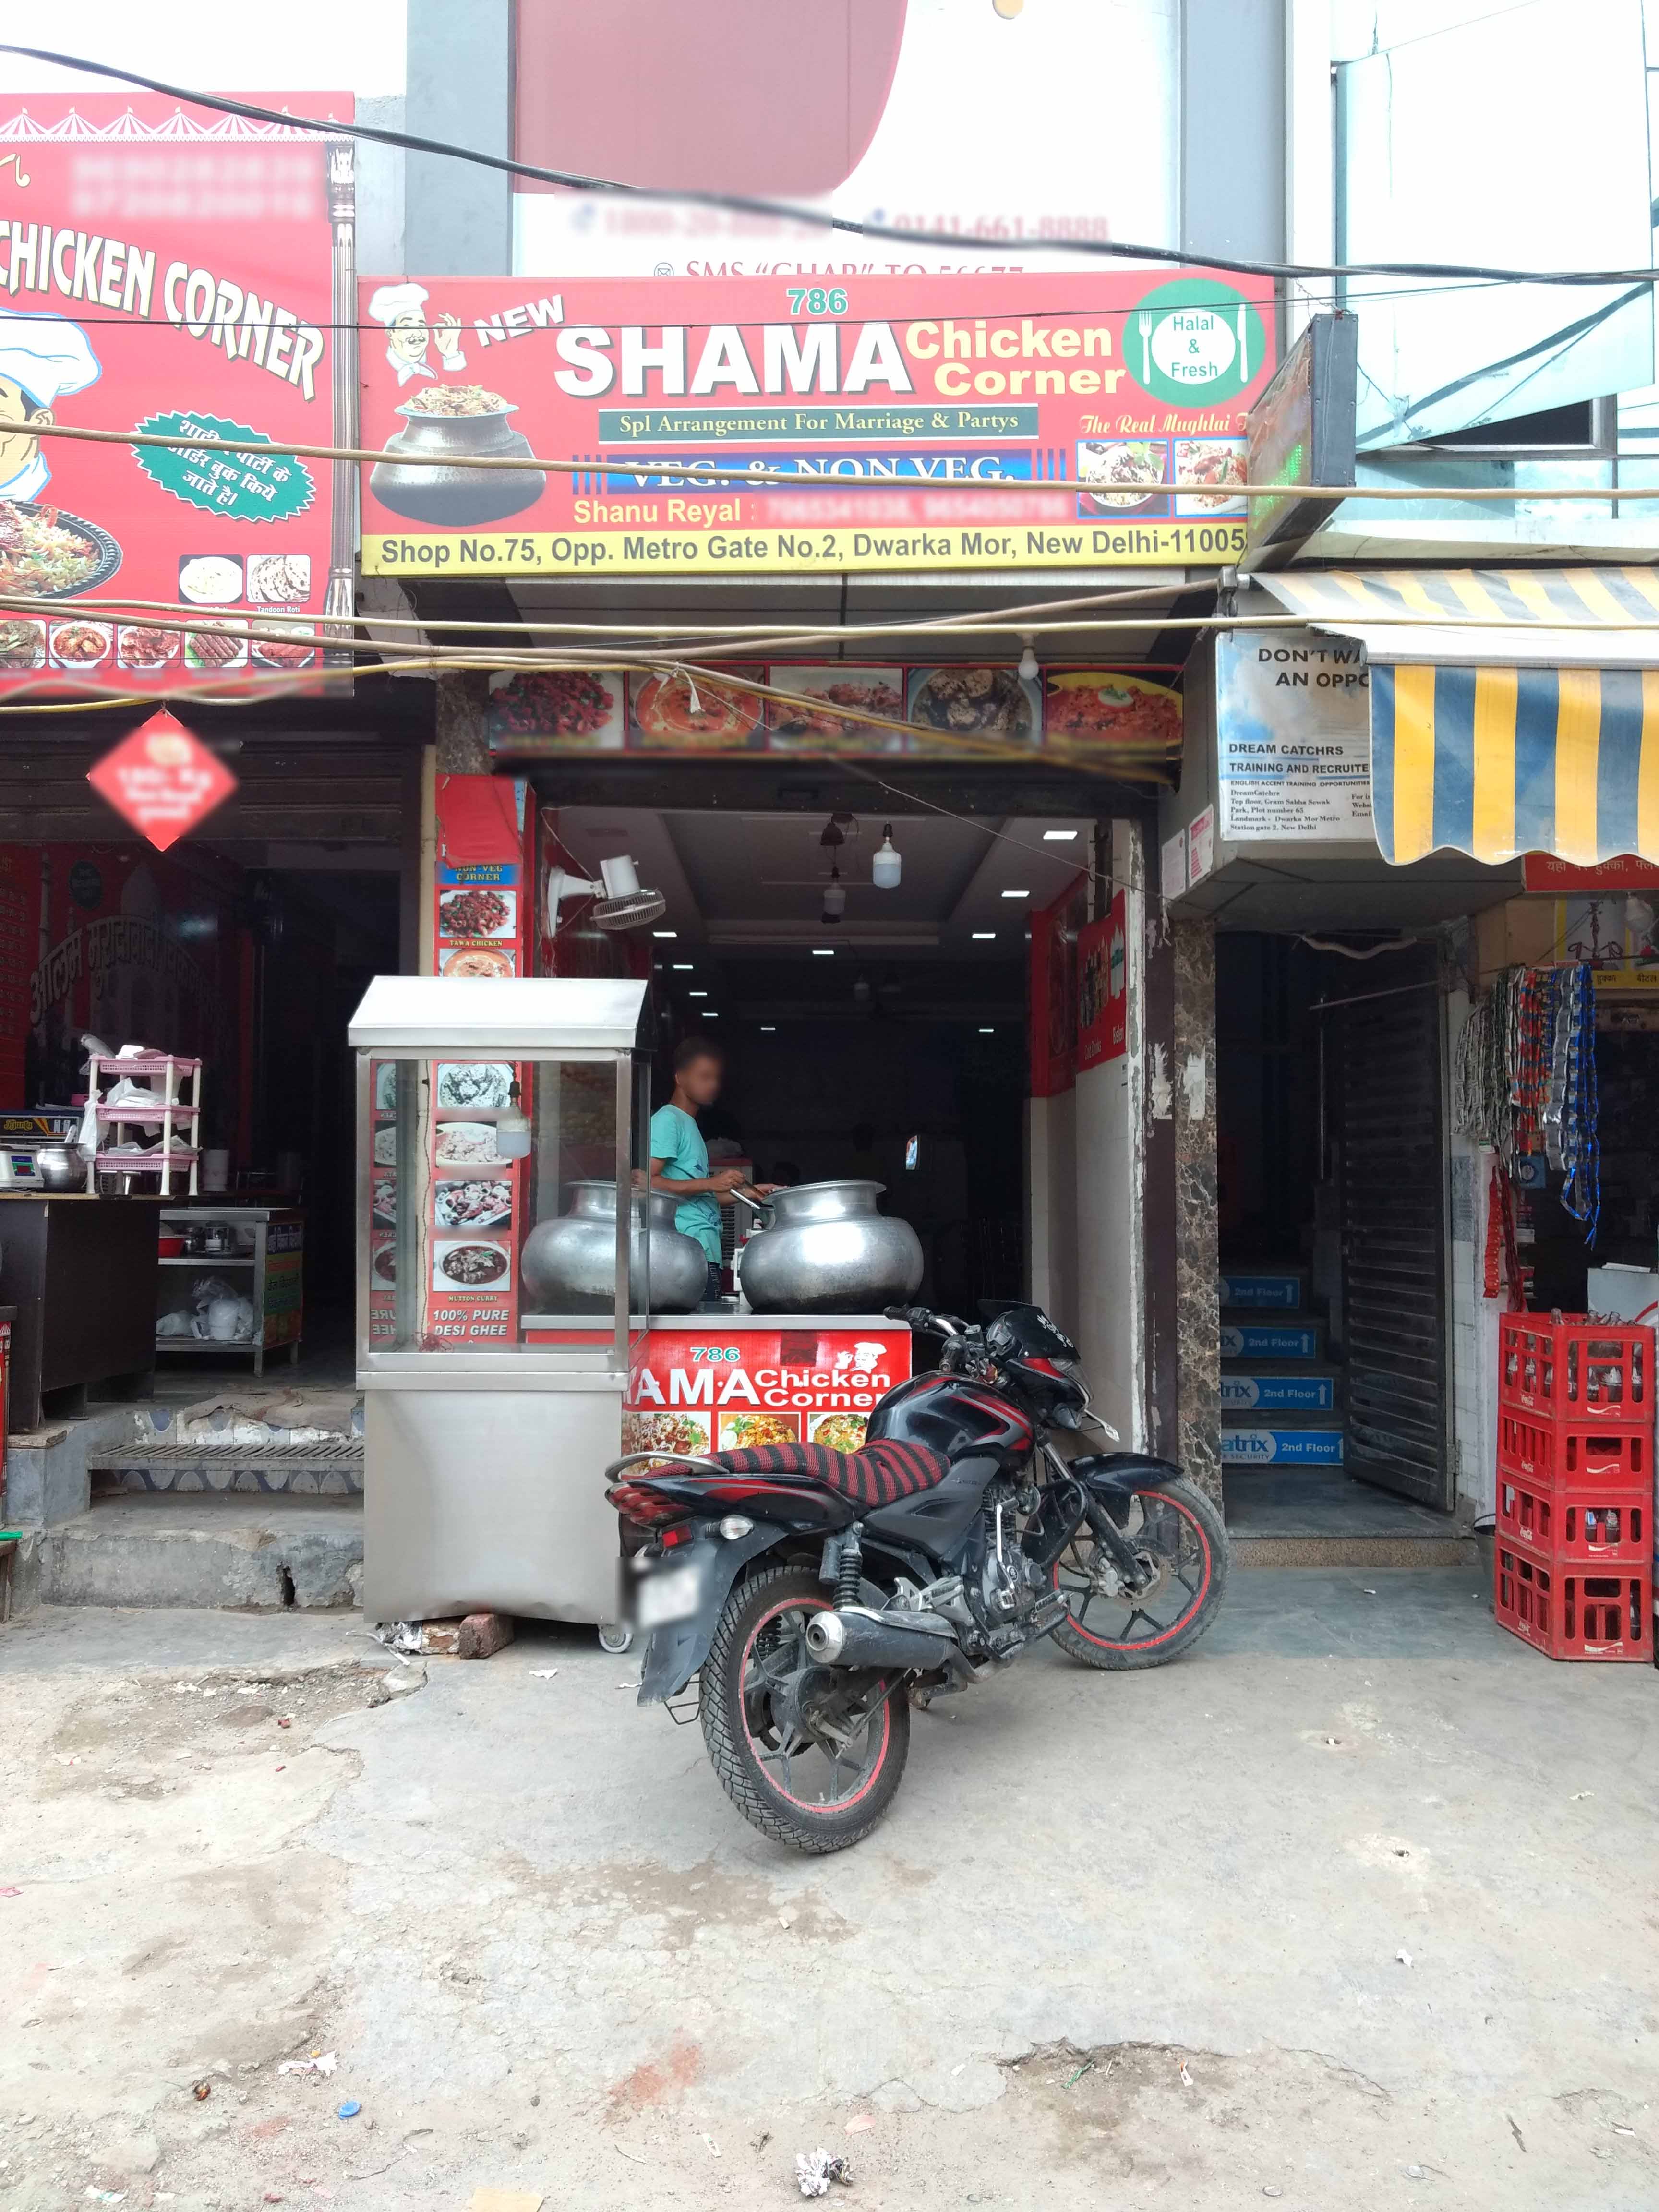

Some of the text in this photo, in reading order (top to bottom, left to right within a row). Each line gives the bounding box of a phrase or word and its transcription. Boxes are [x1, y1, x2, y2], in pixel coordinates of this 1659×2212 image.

[787, 288, 848, 315] 786
[473, 294, 565, 348] NEW
[1173, 316, 1214, 331] Halal
[164, 261, 325, 401] CORNER
[1189, 338, 1200, 353] &
[554, 320, 1112, 397] SHAMA Chicken
[1171, 362, 1218, 377] Fresh
[933, 362, 1127, 396] Corner
[620, 411, 1019, 437] Spl Arrangement For Marriage & Partys
[1080, 414, 1111, 434] The
[1116, 414, 1156, 433] Real
[1159, 413, 1231, 436] Mughlai
[208, 460, 241, 481] बुक
[240, 472, 278, 502] किये
[272, 466, 292, 482] के
[624, 456, 1015, 488] VEG. & NON VEG.
[182, 470, 219, 496] जाते
[574, 500, 657, 524] Shanu
[667, 498, 741, 528] Reyal
[382, 528, 1247, 568] Shop No.75, Opp. Metro Gate No.2, Dwarka Mor, New Delhi-11005
[1275, 673, 1308, 687] AN
[1229, 744, 1344, 756] DREAM CATCHRS
[1230, 763, 1284, 773] TRAINING
[1286, 764, 1310, 773] AND
[1234, 1287, 1283, 1297] 2nd Floor
[433, 1310, 510, 1321] 100% PURE
[434, 1324, 507, 1336] DESI GHEE
[1248, 1337, 1299, 1347] 2nd Floor
[690, 1346, 741, 1362] 786
[625, 1368, 890, 1406] AMA Chicken
[1221, 1380, 1316, 1398] trix 2nd Floor
[1221, 1434, 1336, 1452] atrix 2nd Floor
